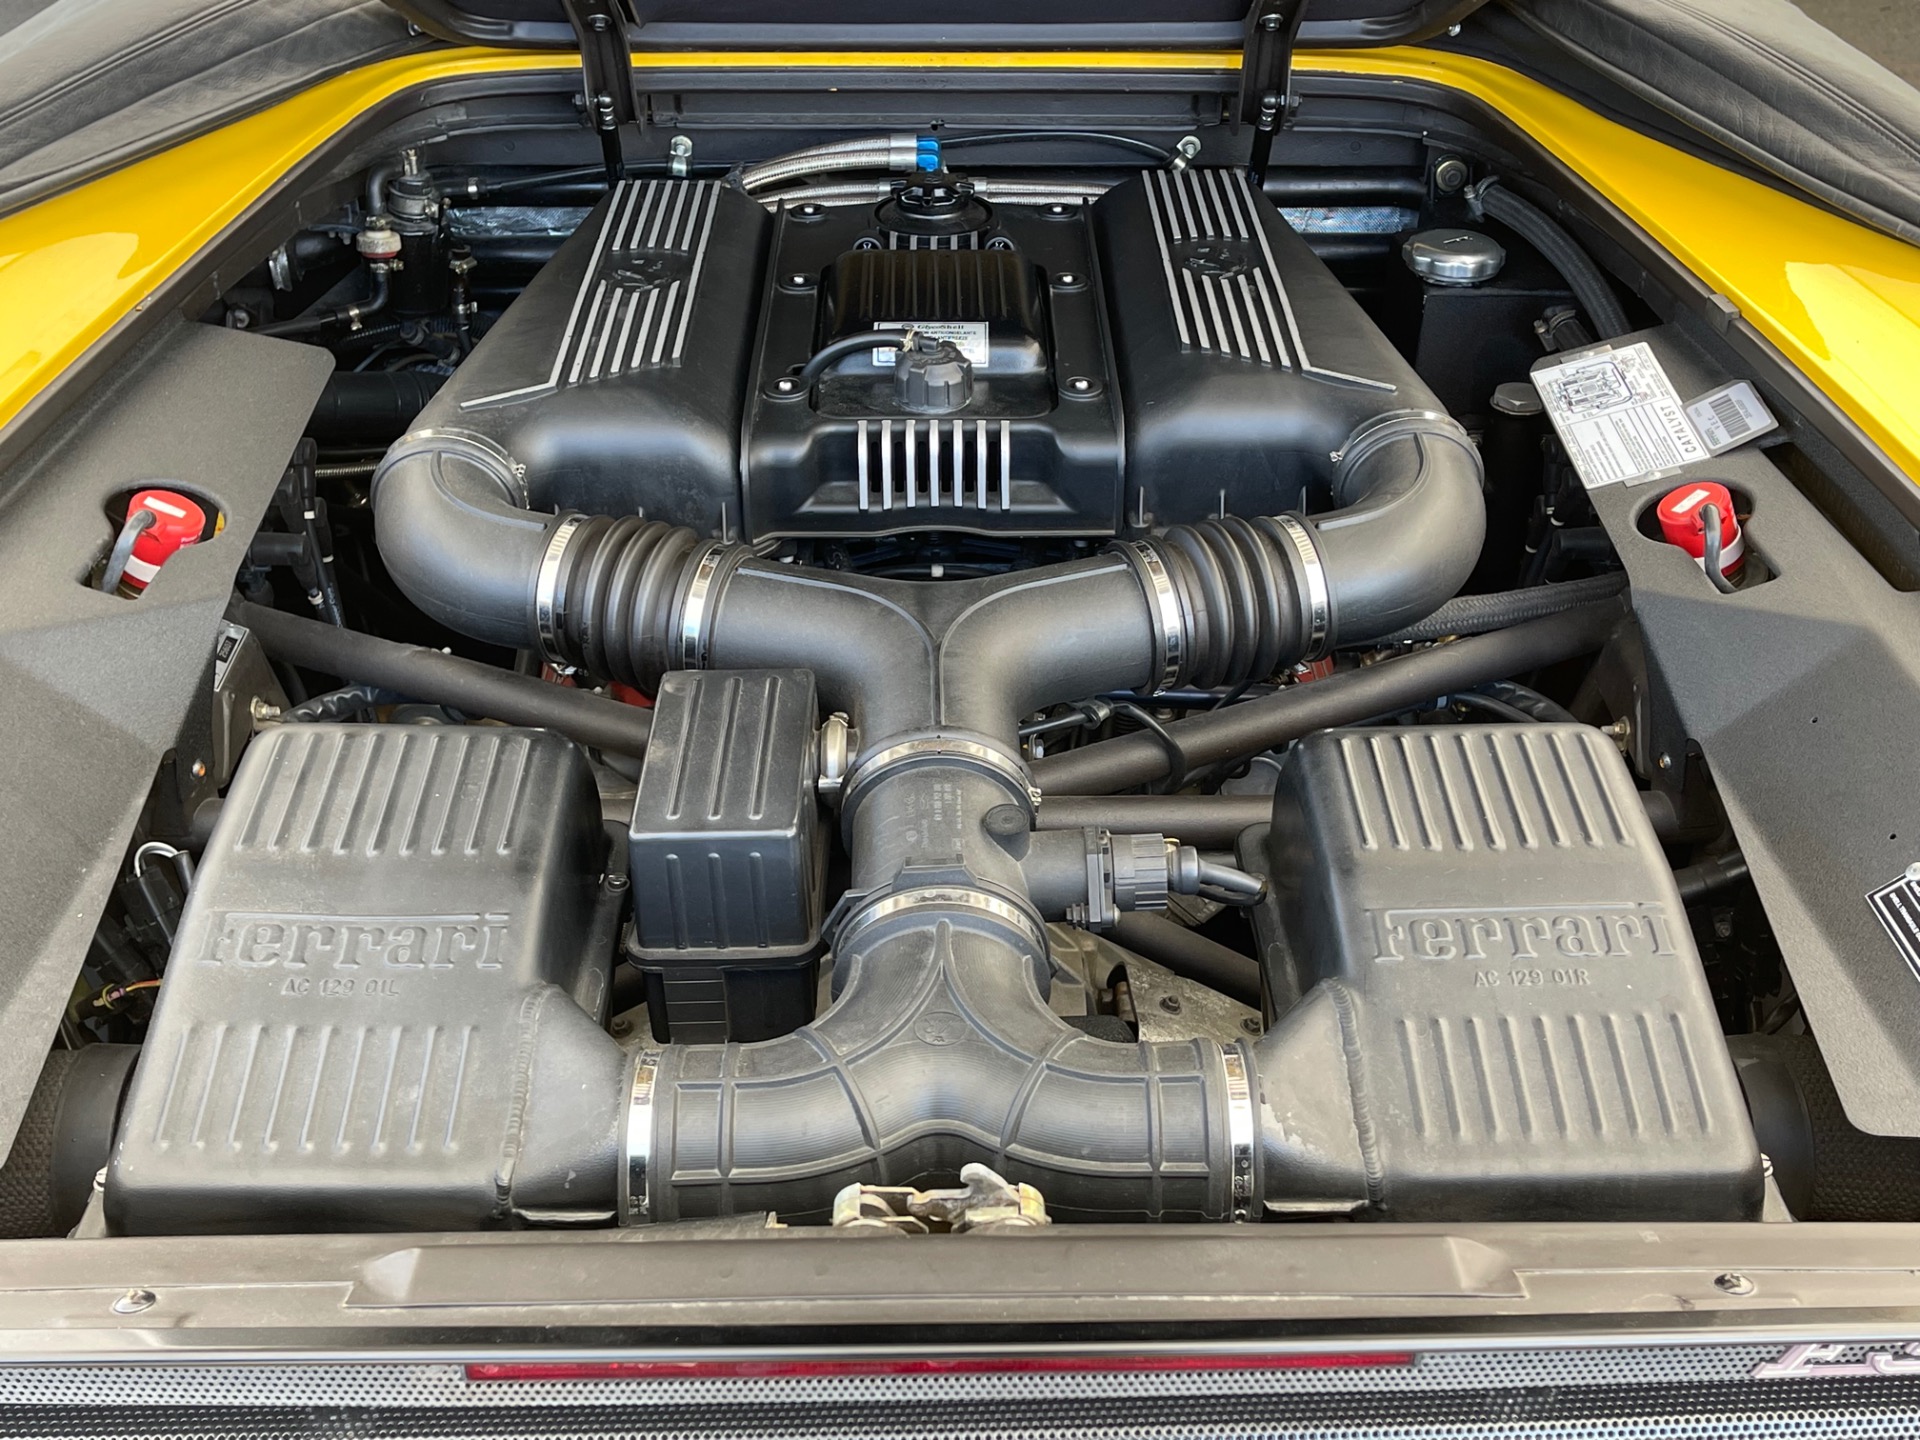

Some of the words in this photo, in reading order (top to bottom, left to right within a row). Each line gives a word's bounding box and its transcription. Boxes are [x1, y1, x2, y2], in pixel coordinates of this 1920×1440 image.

[1660, 405, 1697, 453] CATALYST
[200, 911, 509, 968] Ferrari
[1363, 902, 1676, 963] Ferrari
[282, 978, 310, 996] AC
[319, 978, 355, 995] 129
[1474, 969, 1500, 988] AC
[1507, 968, 1544, 986] 129
